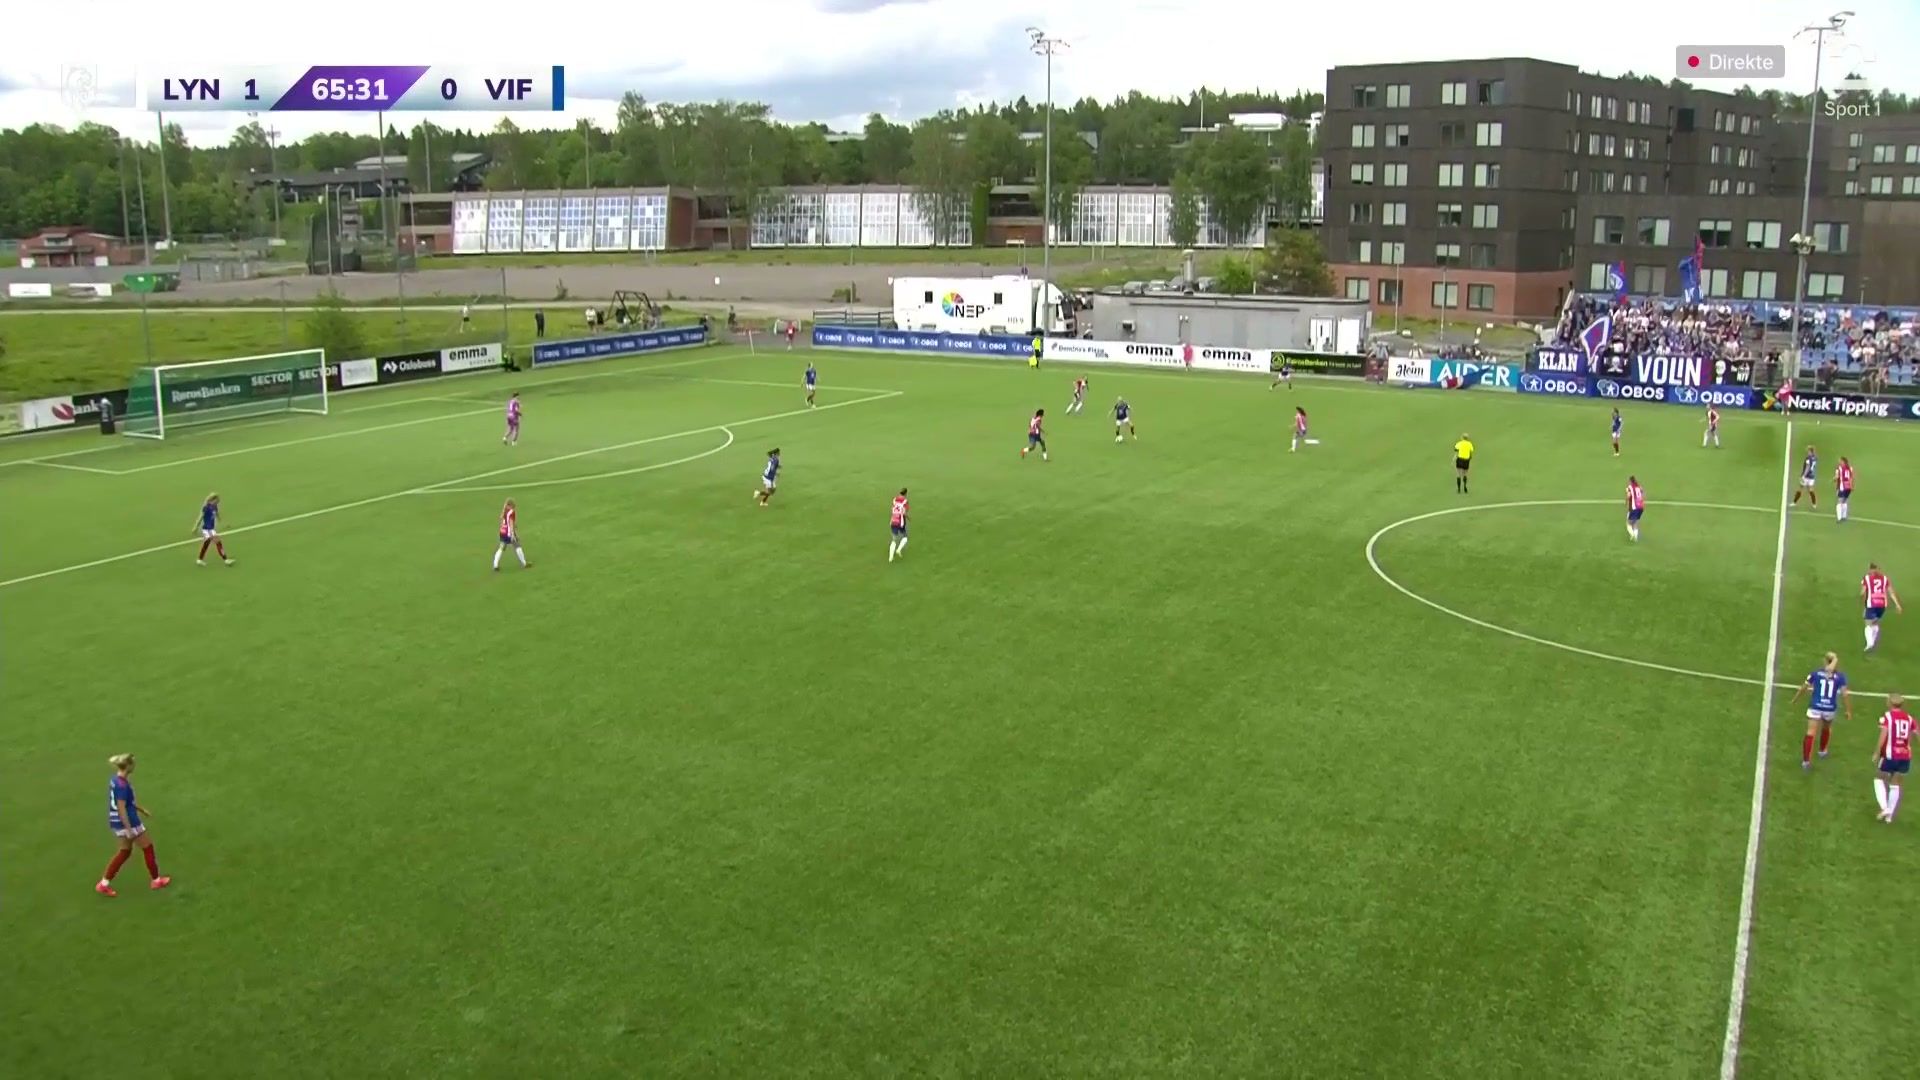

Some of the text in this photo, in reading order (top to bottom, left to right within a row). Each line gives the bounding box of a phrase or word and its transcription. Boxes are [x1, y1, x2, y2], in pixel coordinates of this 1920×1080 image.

[955, 304, 985, 318] NEP
[449, 347, 488, 361] emma
[1126, 344, 1173, 356] emma
[1202, 348, 1251, 361] emma
[1538, 351, 1578, 372] KLAN
[251, 372, 293, 387] SECTOR
[1621, 385, 1664, 400] OBOS
[1701, 391, 1745, 406] OBOS
[1787, 395, 1889, 416] Norsk Tipping
[1873, 579, 1882, 593] 2
[1819, 679, 1834, 698] 11
[1894, 718, 1909, 739] 19
